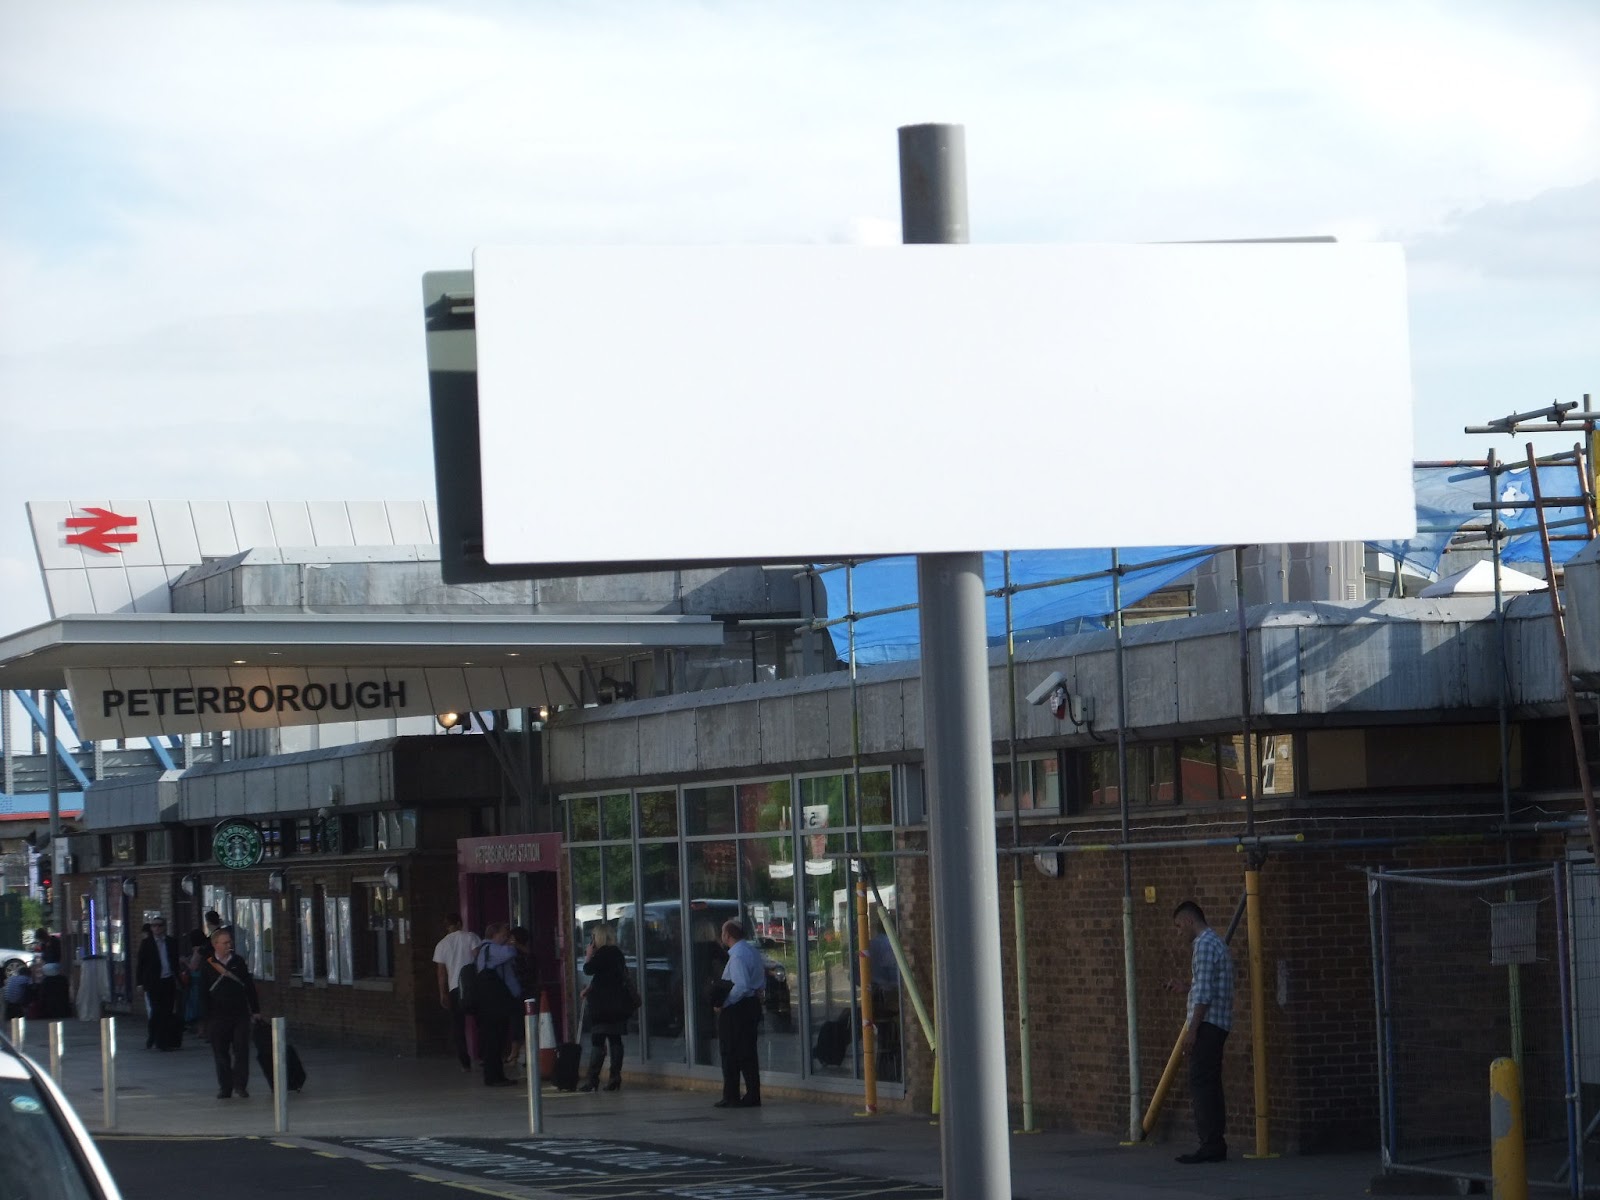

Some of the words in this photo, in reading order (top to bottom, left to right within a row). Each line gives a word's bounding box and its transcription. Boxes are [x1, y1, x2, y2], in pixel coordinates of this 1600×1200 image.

[102, 680, 407, 718] PETERBOROUGH
[217, 826, 256, 847] STARBUCKS
[223, 856, 253, 868] COFFEE
